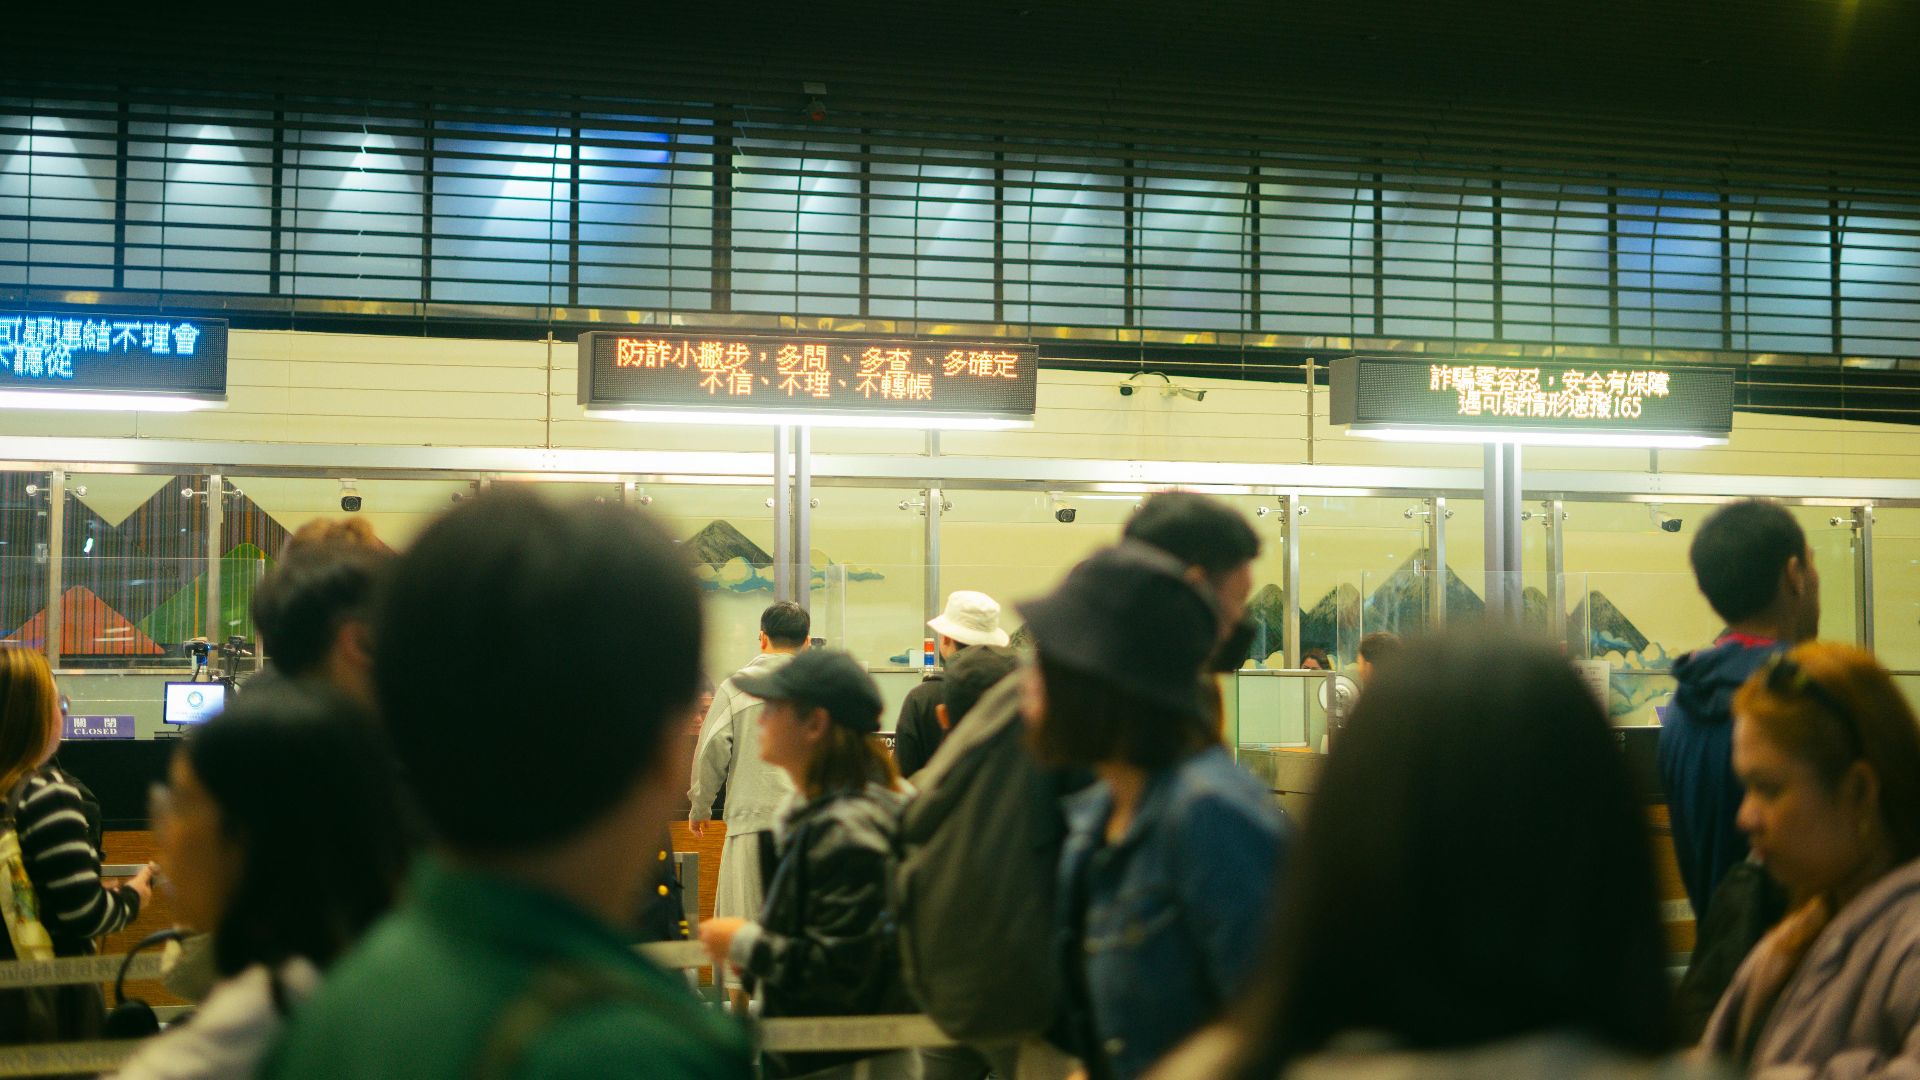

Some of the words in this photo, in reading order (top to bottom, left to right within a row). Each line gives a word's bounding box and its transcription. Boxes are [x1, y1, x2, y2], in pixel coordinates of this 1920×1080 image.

[700, 368, 932, 400] 不信、不理、不轉帳
[1458, 390, 1642, 419] 遇可疑情形速撥165
